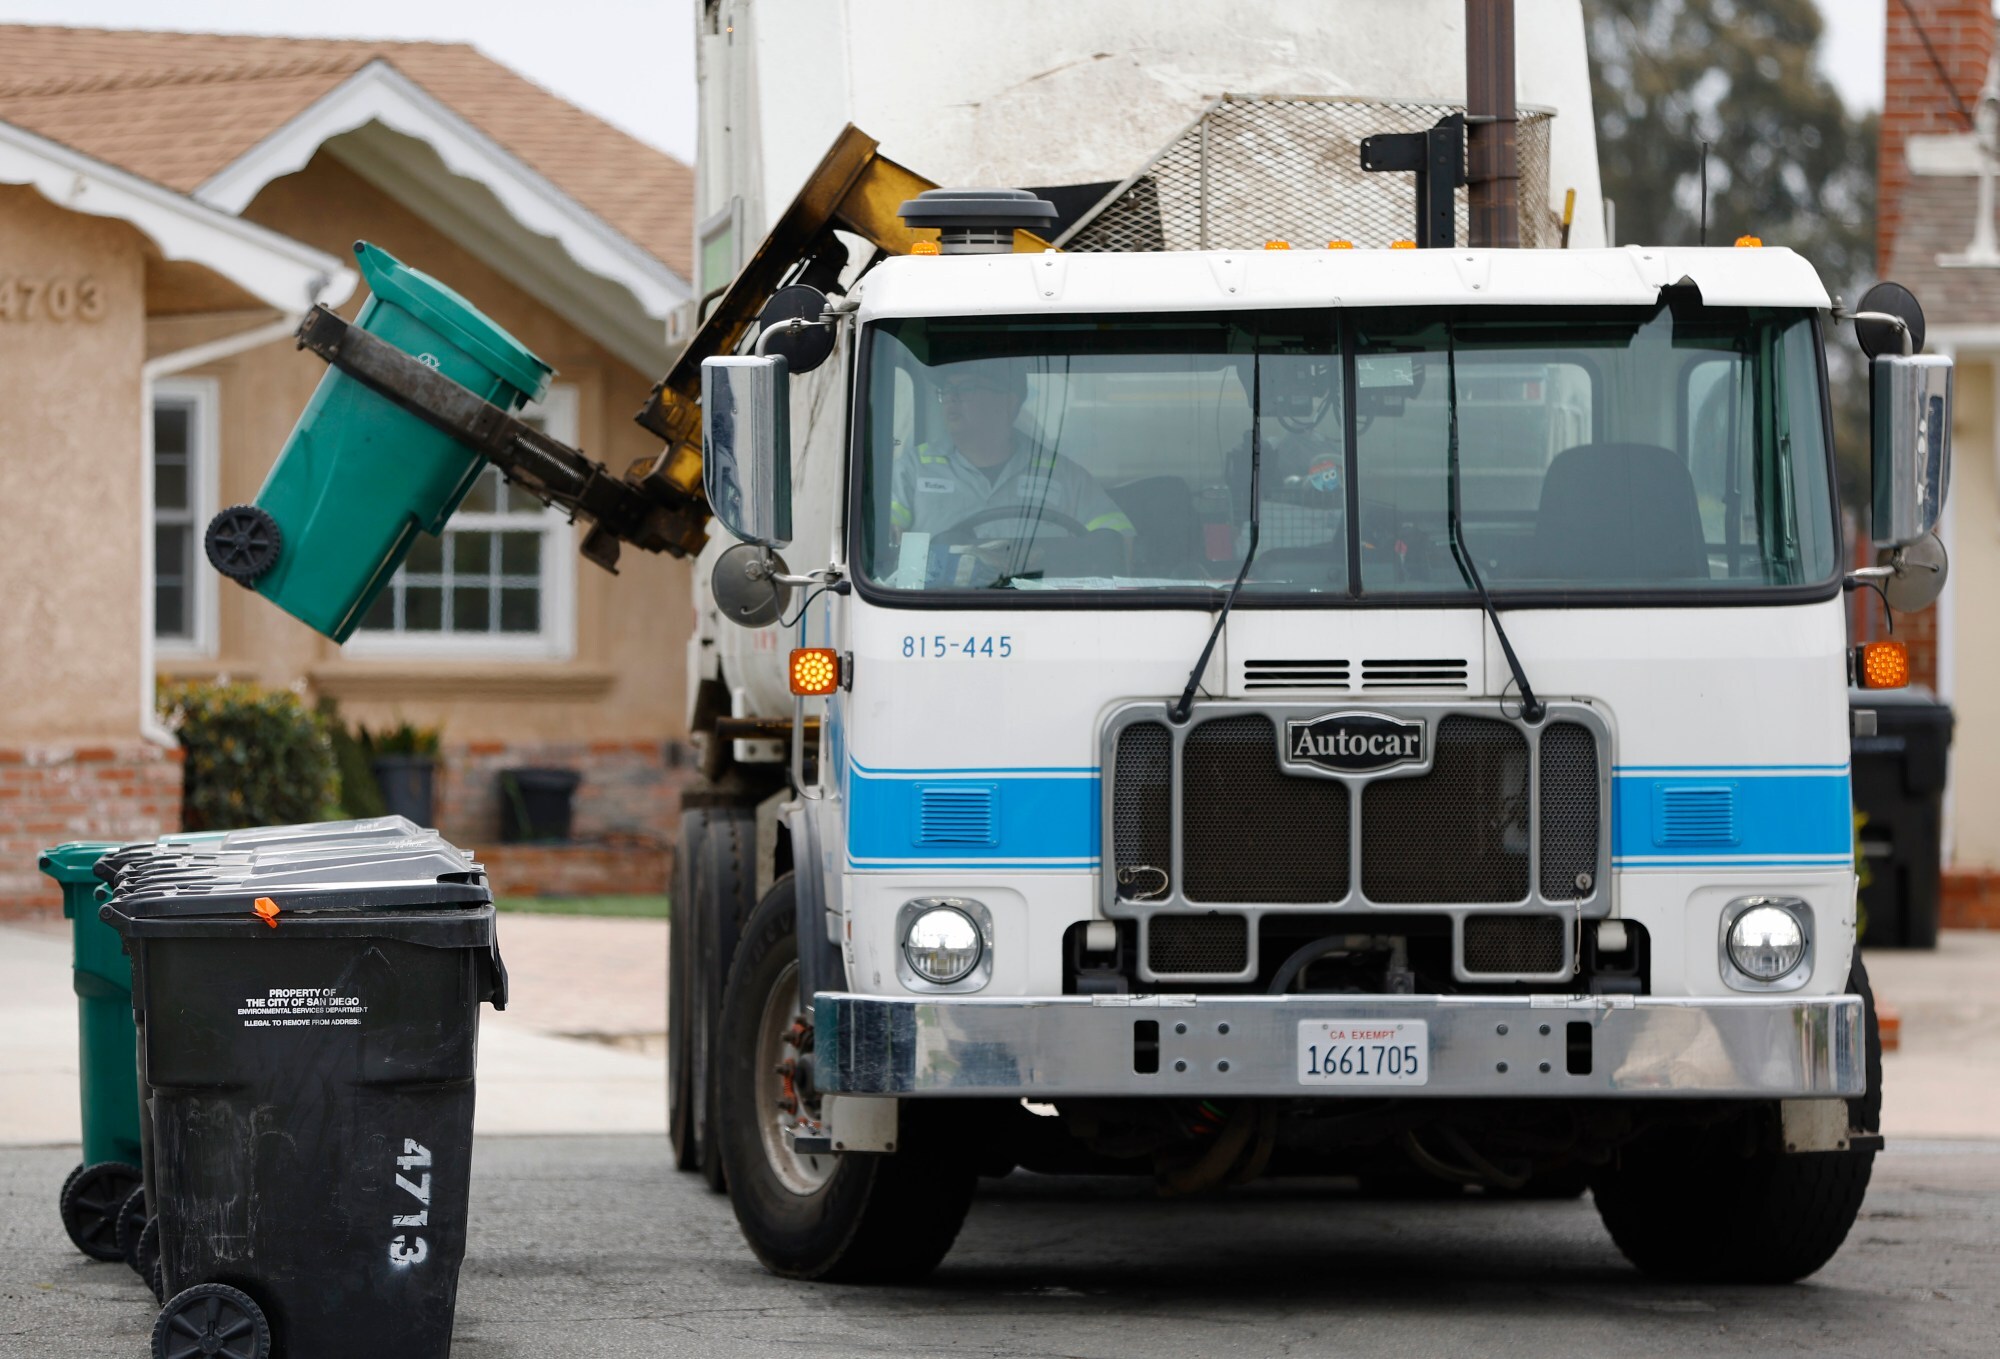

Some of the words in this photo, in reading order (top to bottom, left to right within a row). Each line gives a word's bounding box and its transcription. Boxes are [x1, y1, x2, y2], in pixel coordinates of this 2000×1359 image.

[902, 635, 1012, 658] 815-445
[1293, 727, 1419, 756] Autocar
[246, 998, 266, 1007] THE
[267, 998, 289, 1007] CITY
[291, 998, 305, 1007] OF
[306, 998, 327, 1007] SAN
[329, 997, 360, 1006] DIEGO
[269, 988, 321, 998] PROPERTY
[322, 988, 337, 997] OF
[1330, 1031, 1346, 1040] CA
[1351, 1031, 1396, 1040] EXEMPT
[1307, 1045, 1418, 1075] 1661705
[390, 1138, 432, 1266] 4713
